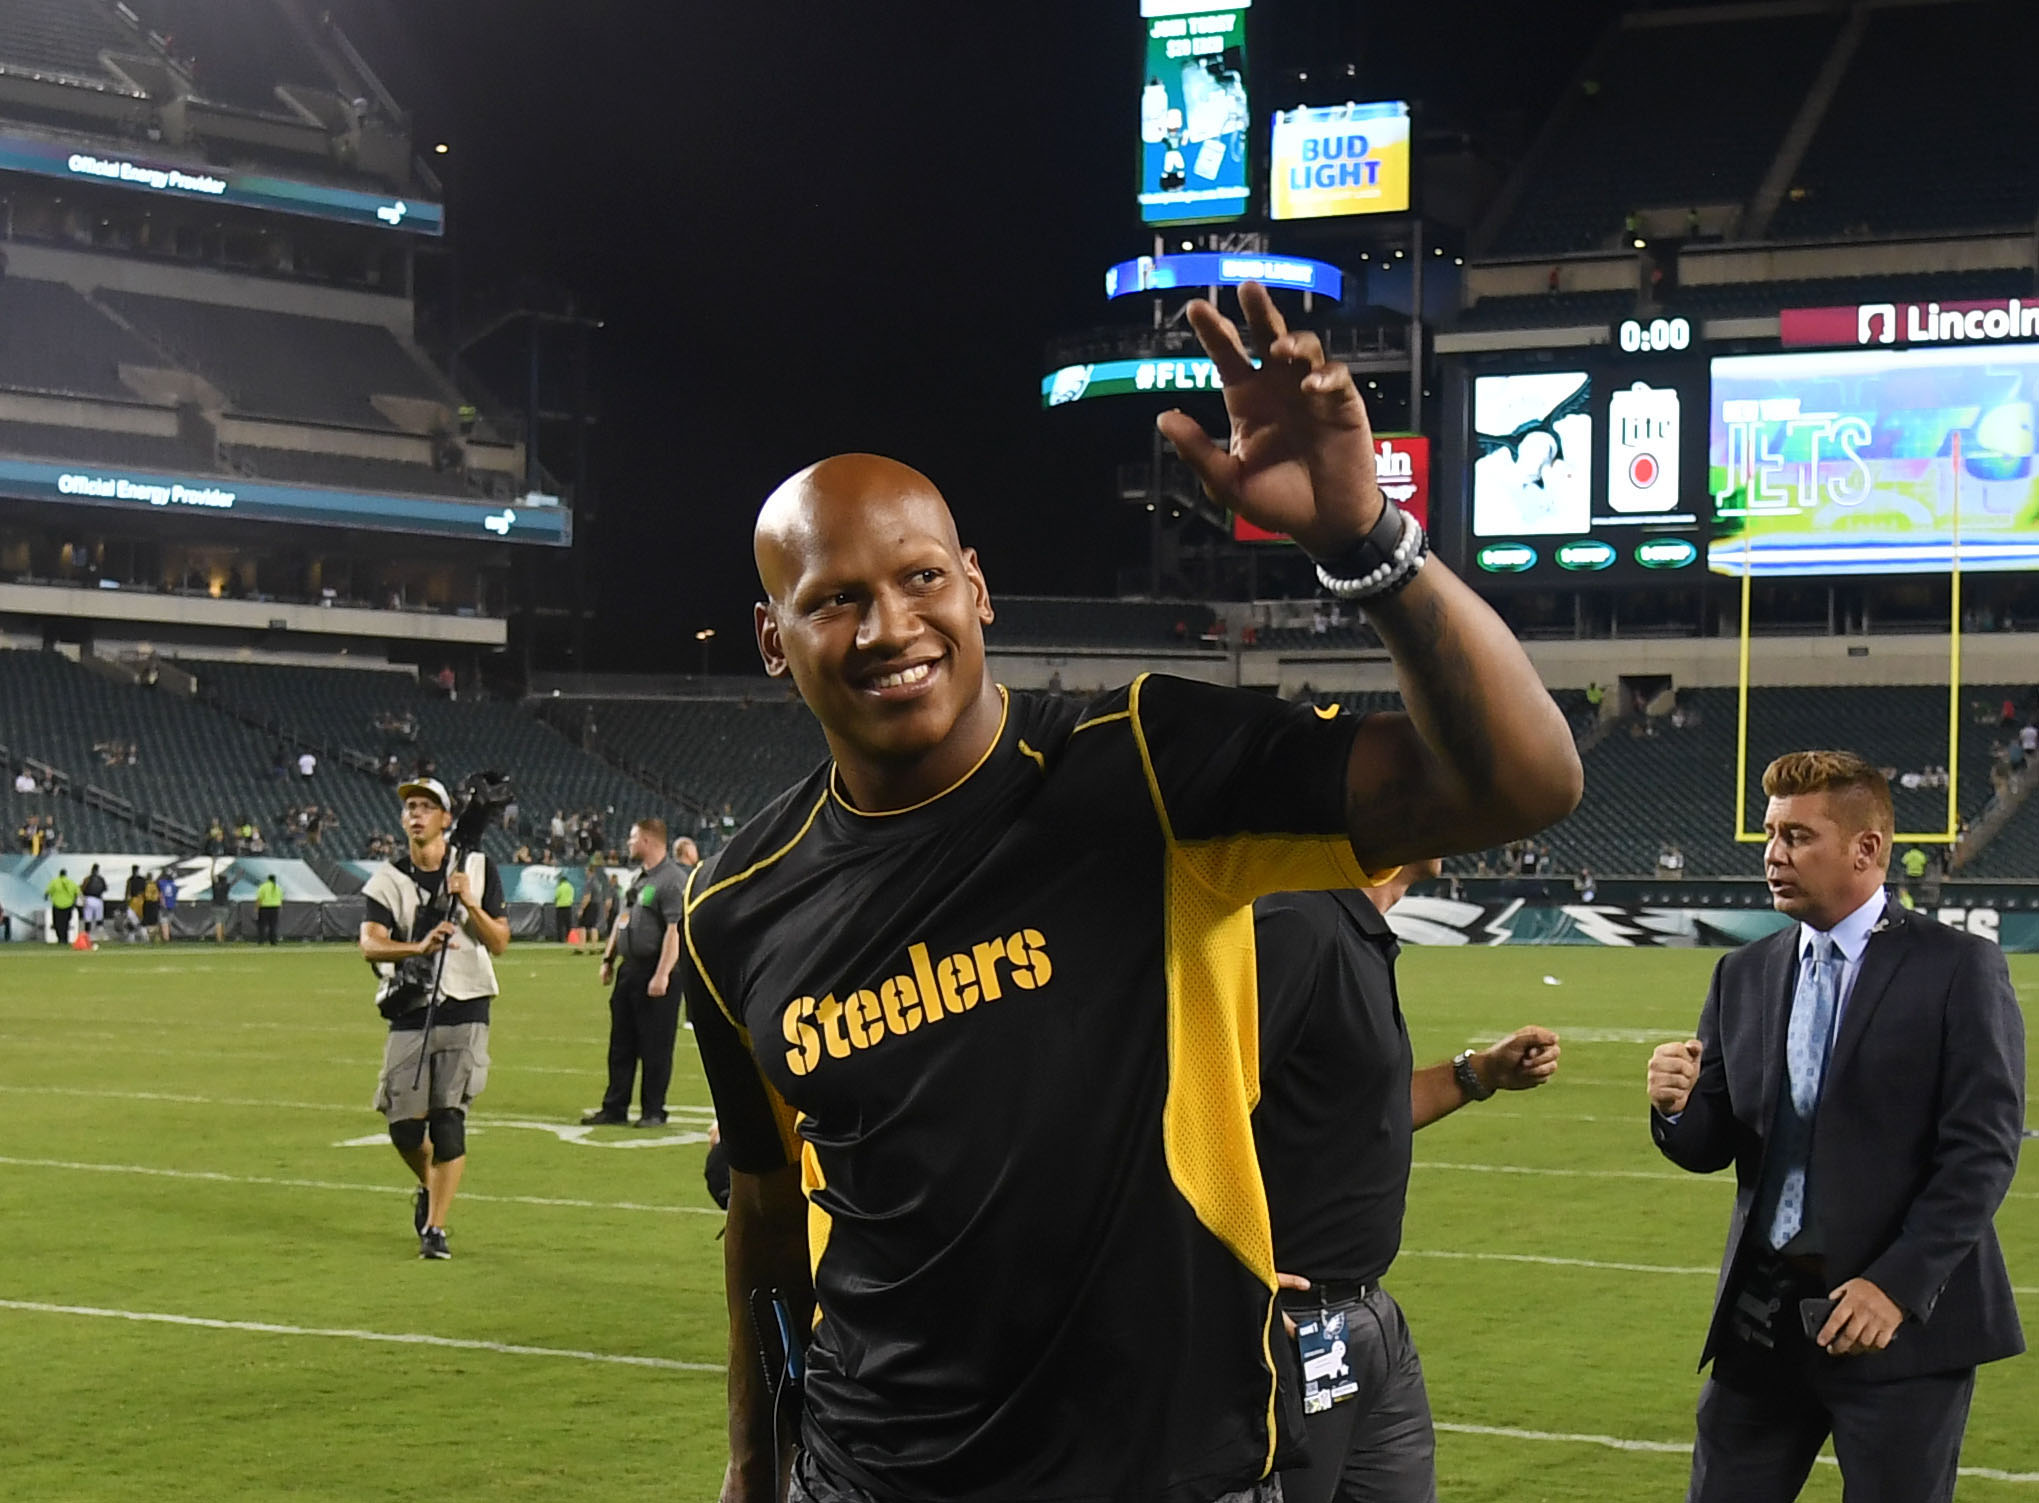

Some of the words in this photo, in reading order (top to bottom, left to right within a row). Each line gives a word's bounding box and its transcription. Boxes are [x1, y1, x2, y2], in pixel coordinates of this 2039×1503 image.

[1301, 135, 1369, 162] BUD
[68, 154, 120, 178] Official
[120, 162, 169, 189] Energy
[168, 170, 227, 195] Provider
[1290, 160, 1381, 190] LIGHT
[1620, 317, 1690, 352] 0:00
[1907, 298, 2039, 342] Lincoln
[1716, 416, 1872, 507] JETS
[57, 474, 116, 497] Official
[116, 479, 171, 506] Energy
[171, 484, 236, 508] Provider
[782, 928, 1053, 1076] Steelers
